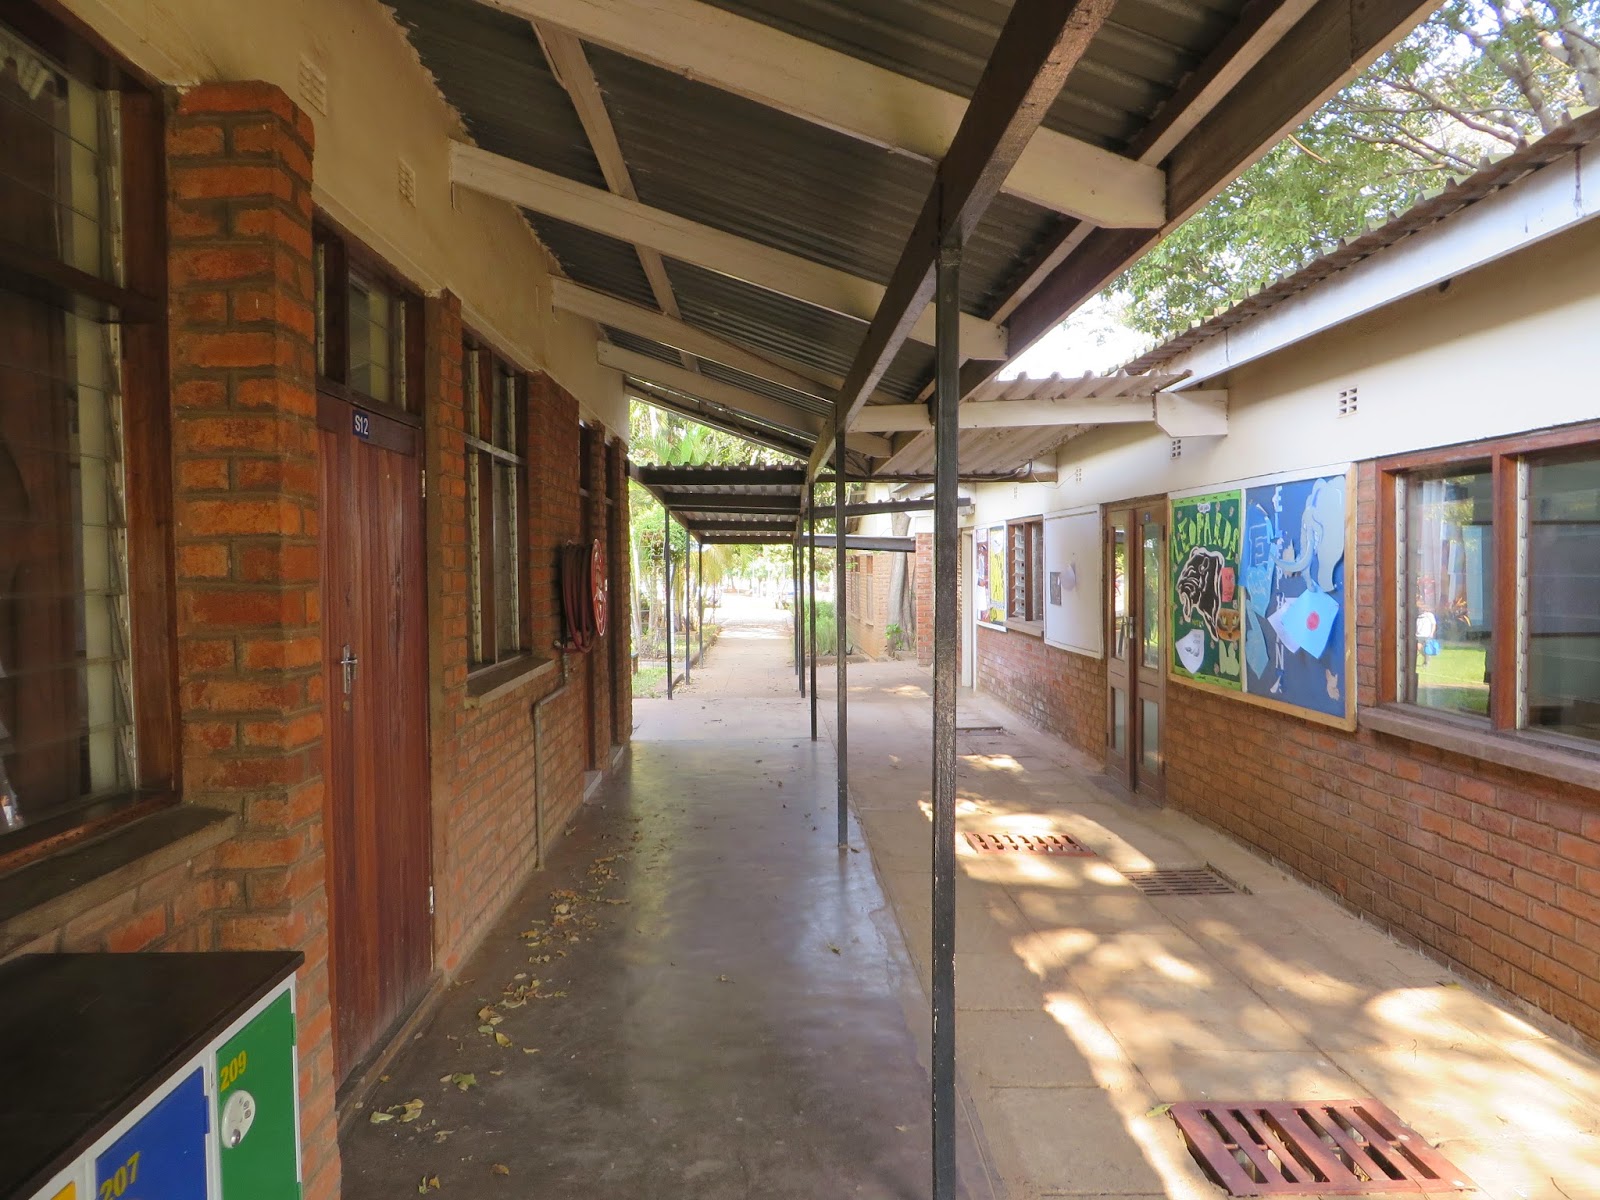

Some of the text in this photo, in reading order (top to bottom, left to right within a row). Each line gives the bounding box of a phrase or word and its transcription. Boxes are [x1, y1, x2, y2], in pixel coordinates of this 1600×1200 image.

[354, 414, 369, 436] S12
[1172, 511, 1240, 565] LEOPARDS
[219, 1050, 248, 1092] 209
[99, 1151, 141, 1200] 207
